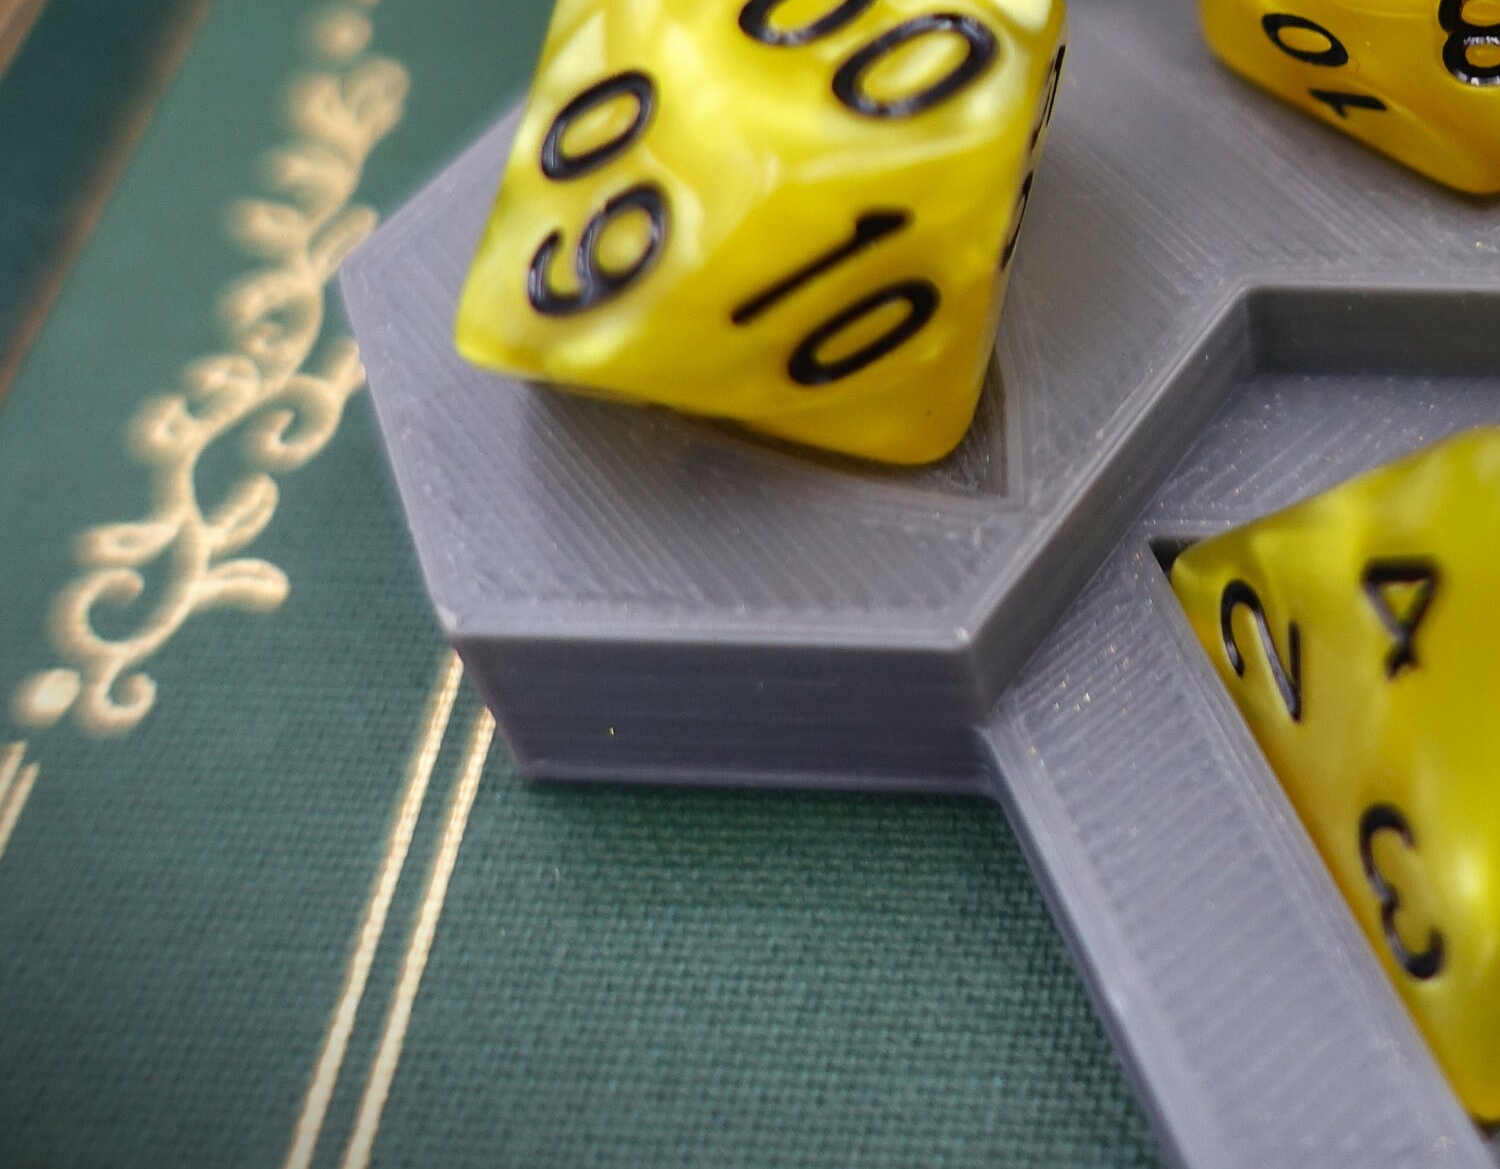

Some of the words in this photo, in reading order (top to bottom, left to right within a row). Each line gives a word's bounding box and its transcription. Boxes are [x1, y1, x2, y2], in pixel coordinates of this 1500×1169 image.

[731, 210, 941, 388] 10
[1221, 579, 1302, 721] 2
[1361, 555, 1439, 680] 4
[1359, 803, 1445, 980] 3
